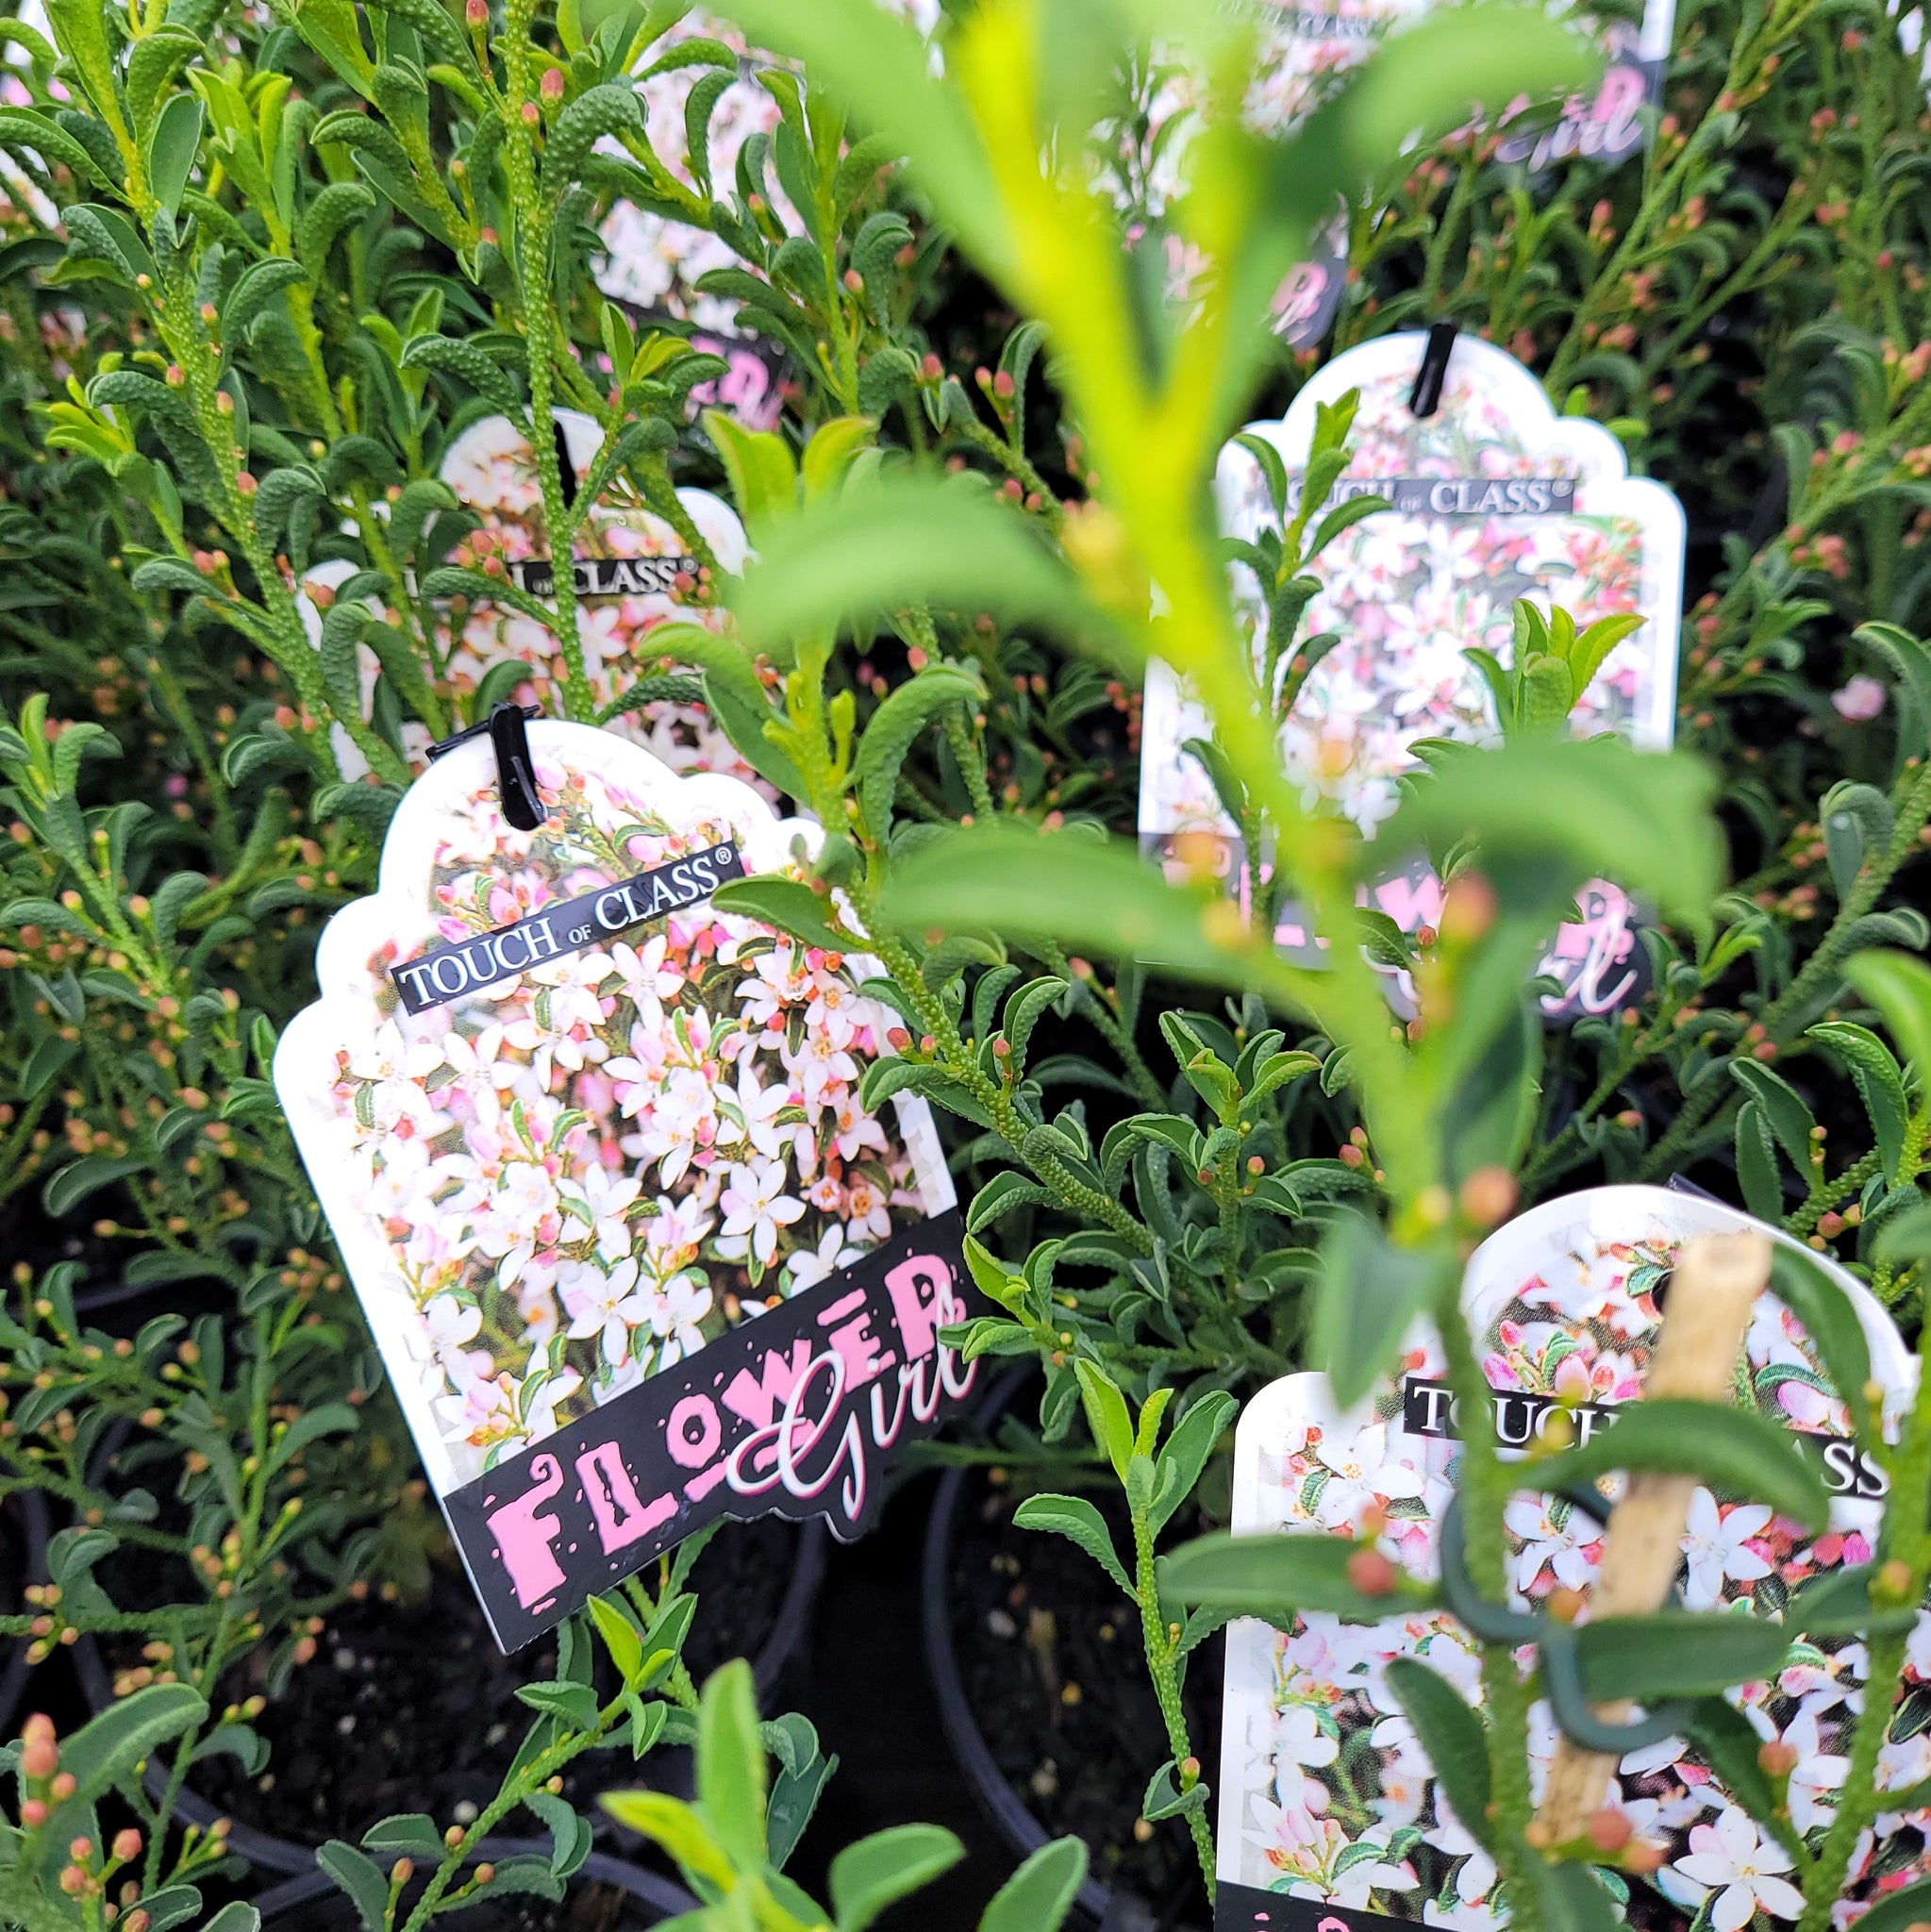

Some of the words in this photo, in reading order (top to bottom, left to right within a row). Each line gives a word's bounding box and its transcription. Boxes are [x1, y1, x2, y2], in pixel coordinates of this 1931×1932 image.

[400, 917, 562, 1007] TOUCH
[568, 924, 592, 944] OF
[485, 1253, 968, 1610] FLOWER
[725, 1281, 979, 1523] Girl
